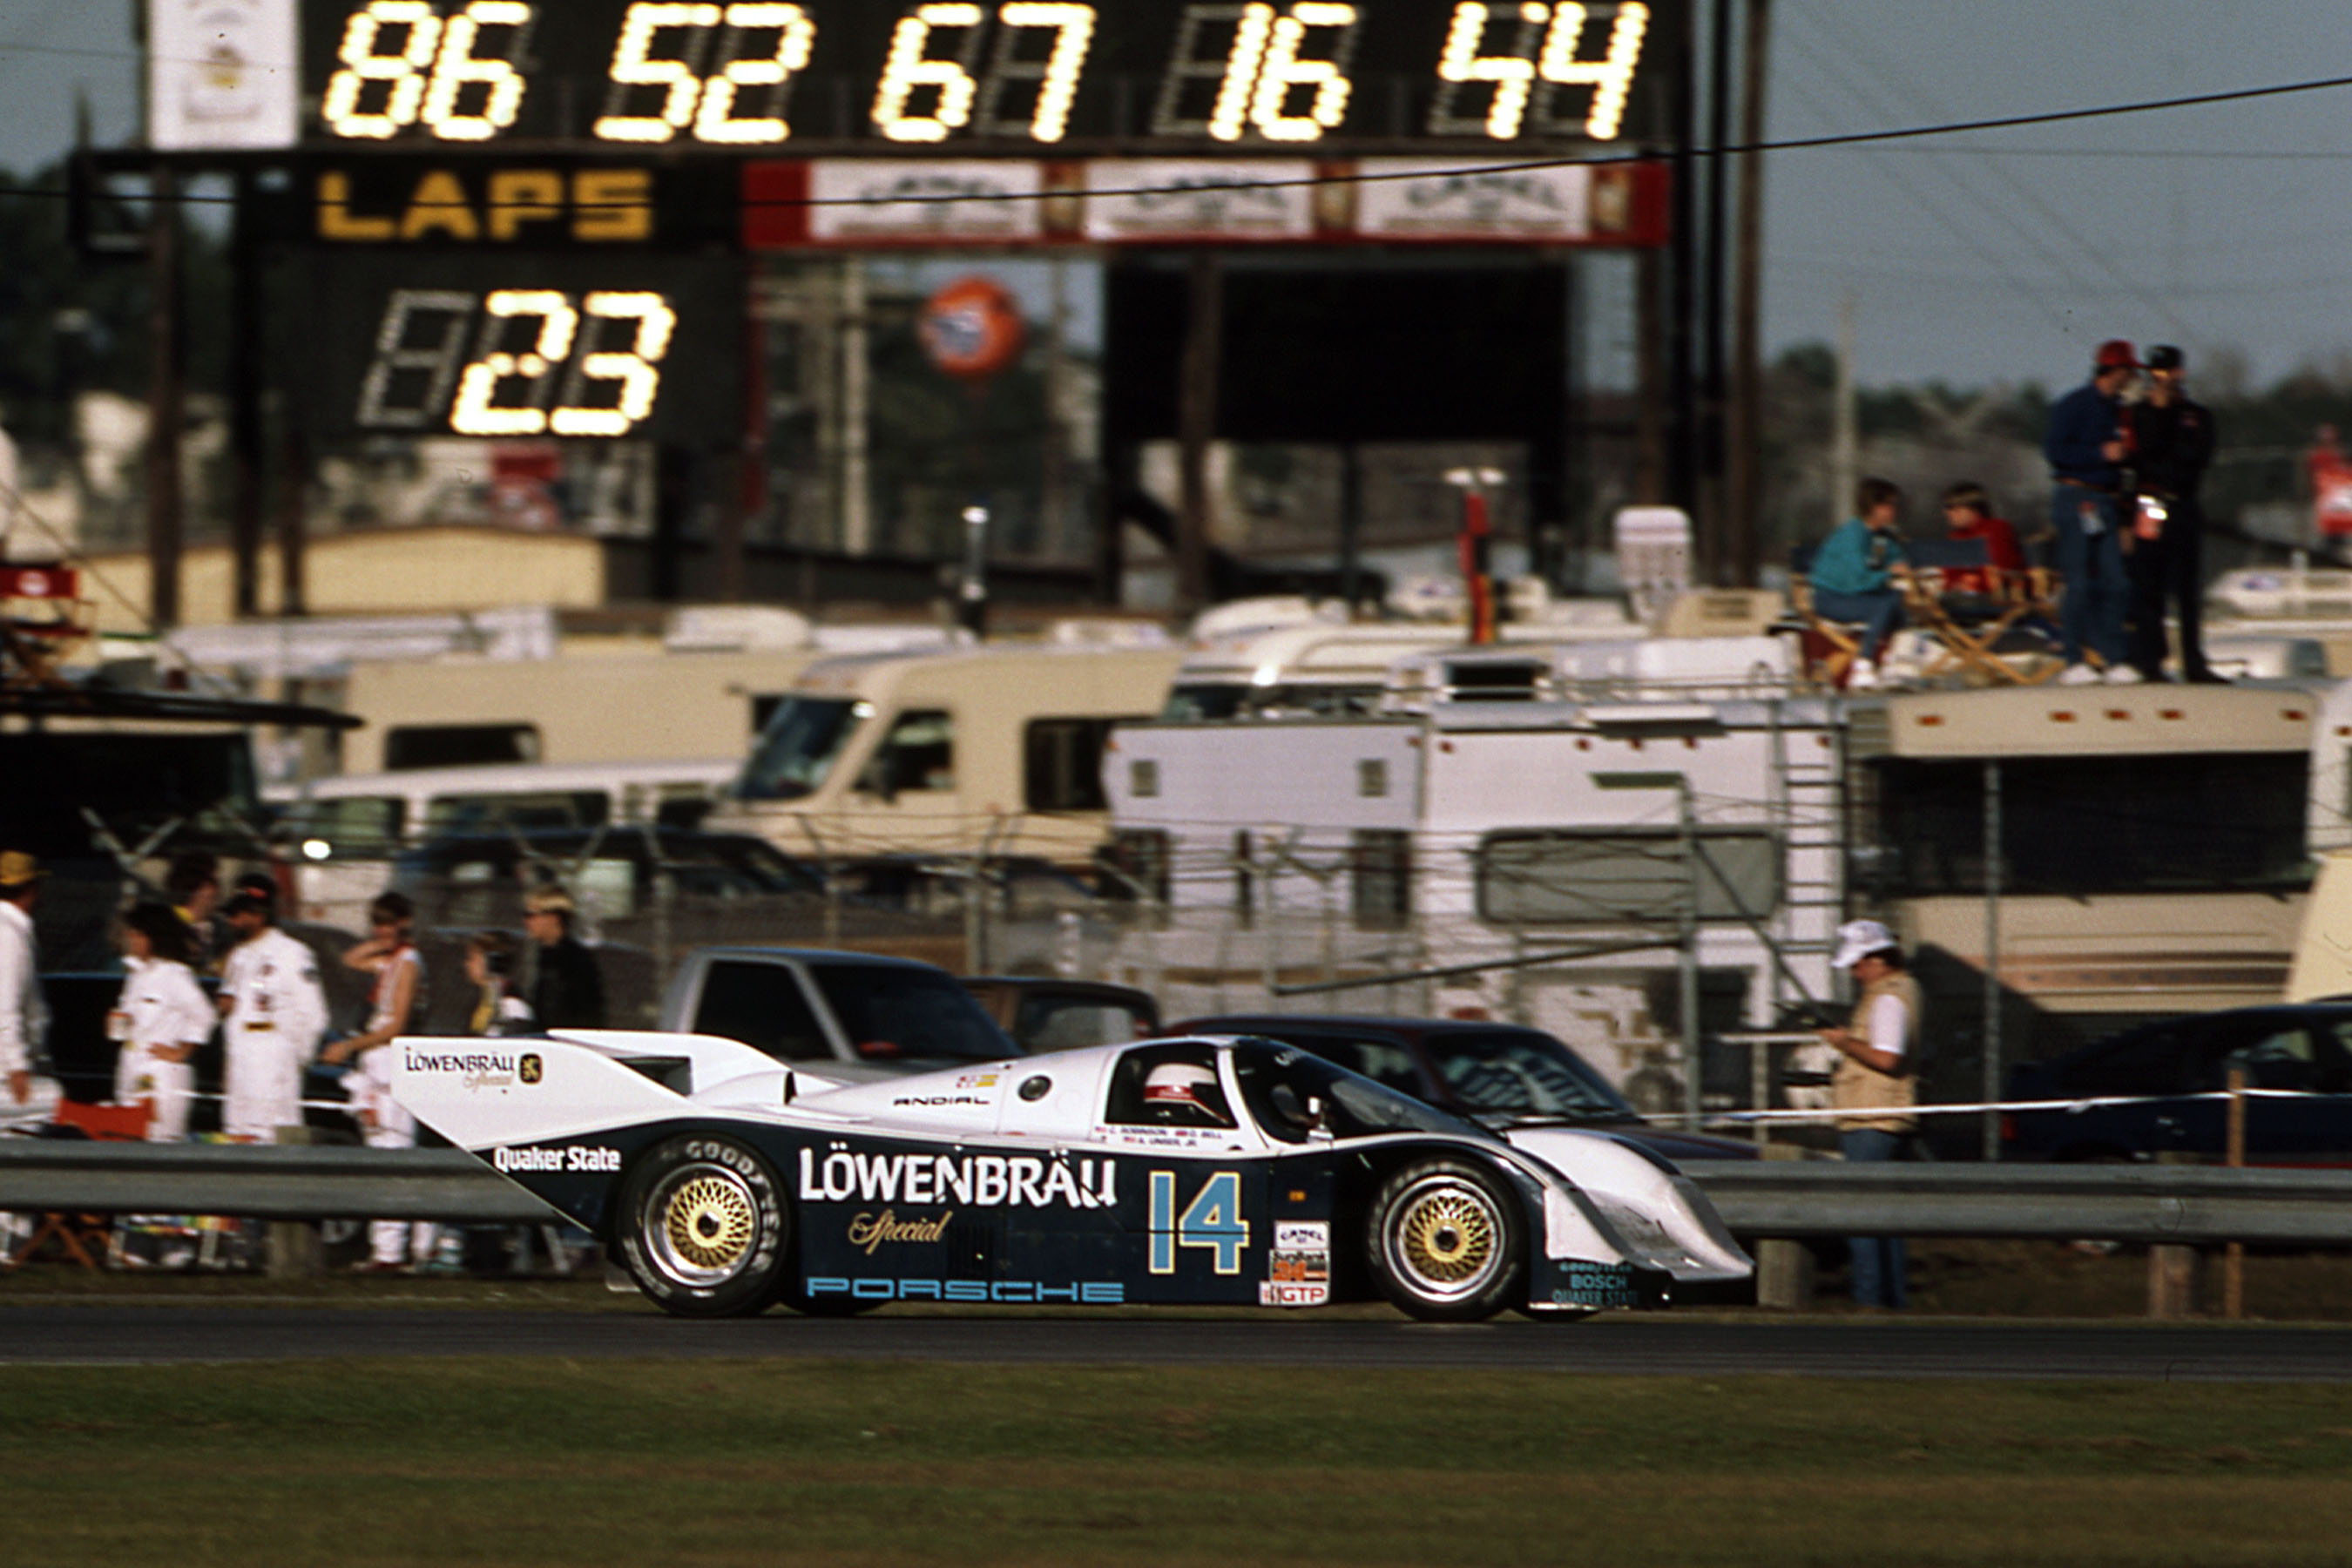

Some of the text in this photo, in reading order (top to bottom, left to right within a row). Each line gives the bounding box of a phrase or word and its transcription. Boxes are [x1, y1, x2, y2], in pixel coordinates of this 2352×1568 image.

[321, 0, 531, 140] 86
[593, 2, 815, 143] 52
[871, 1, 1096, 142] 67
[1206, 1, 1356, 141] 16
[318, 170, 652, 240] LAPS
[449, 290, 676, 436] 23
[893, 1096, 990, 1106] ANDIAL
[494, 1146, 621, 1173] Quaker State
[799, 1141, 1118, 1208] LÖWENBRÄU
[848, 1208, 954, 1255] Special
[1148, 1170, 1250, 1275] 14
[807, 1277, 1125, 1302] PORSCHE
[1281, 1286, 1325, 1302] GTP
[1571, 1274, 1627, 1289] BOSCH
